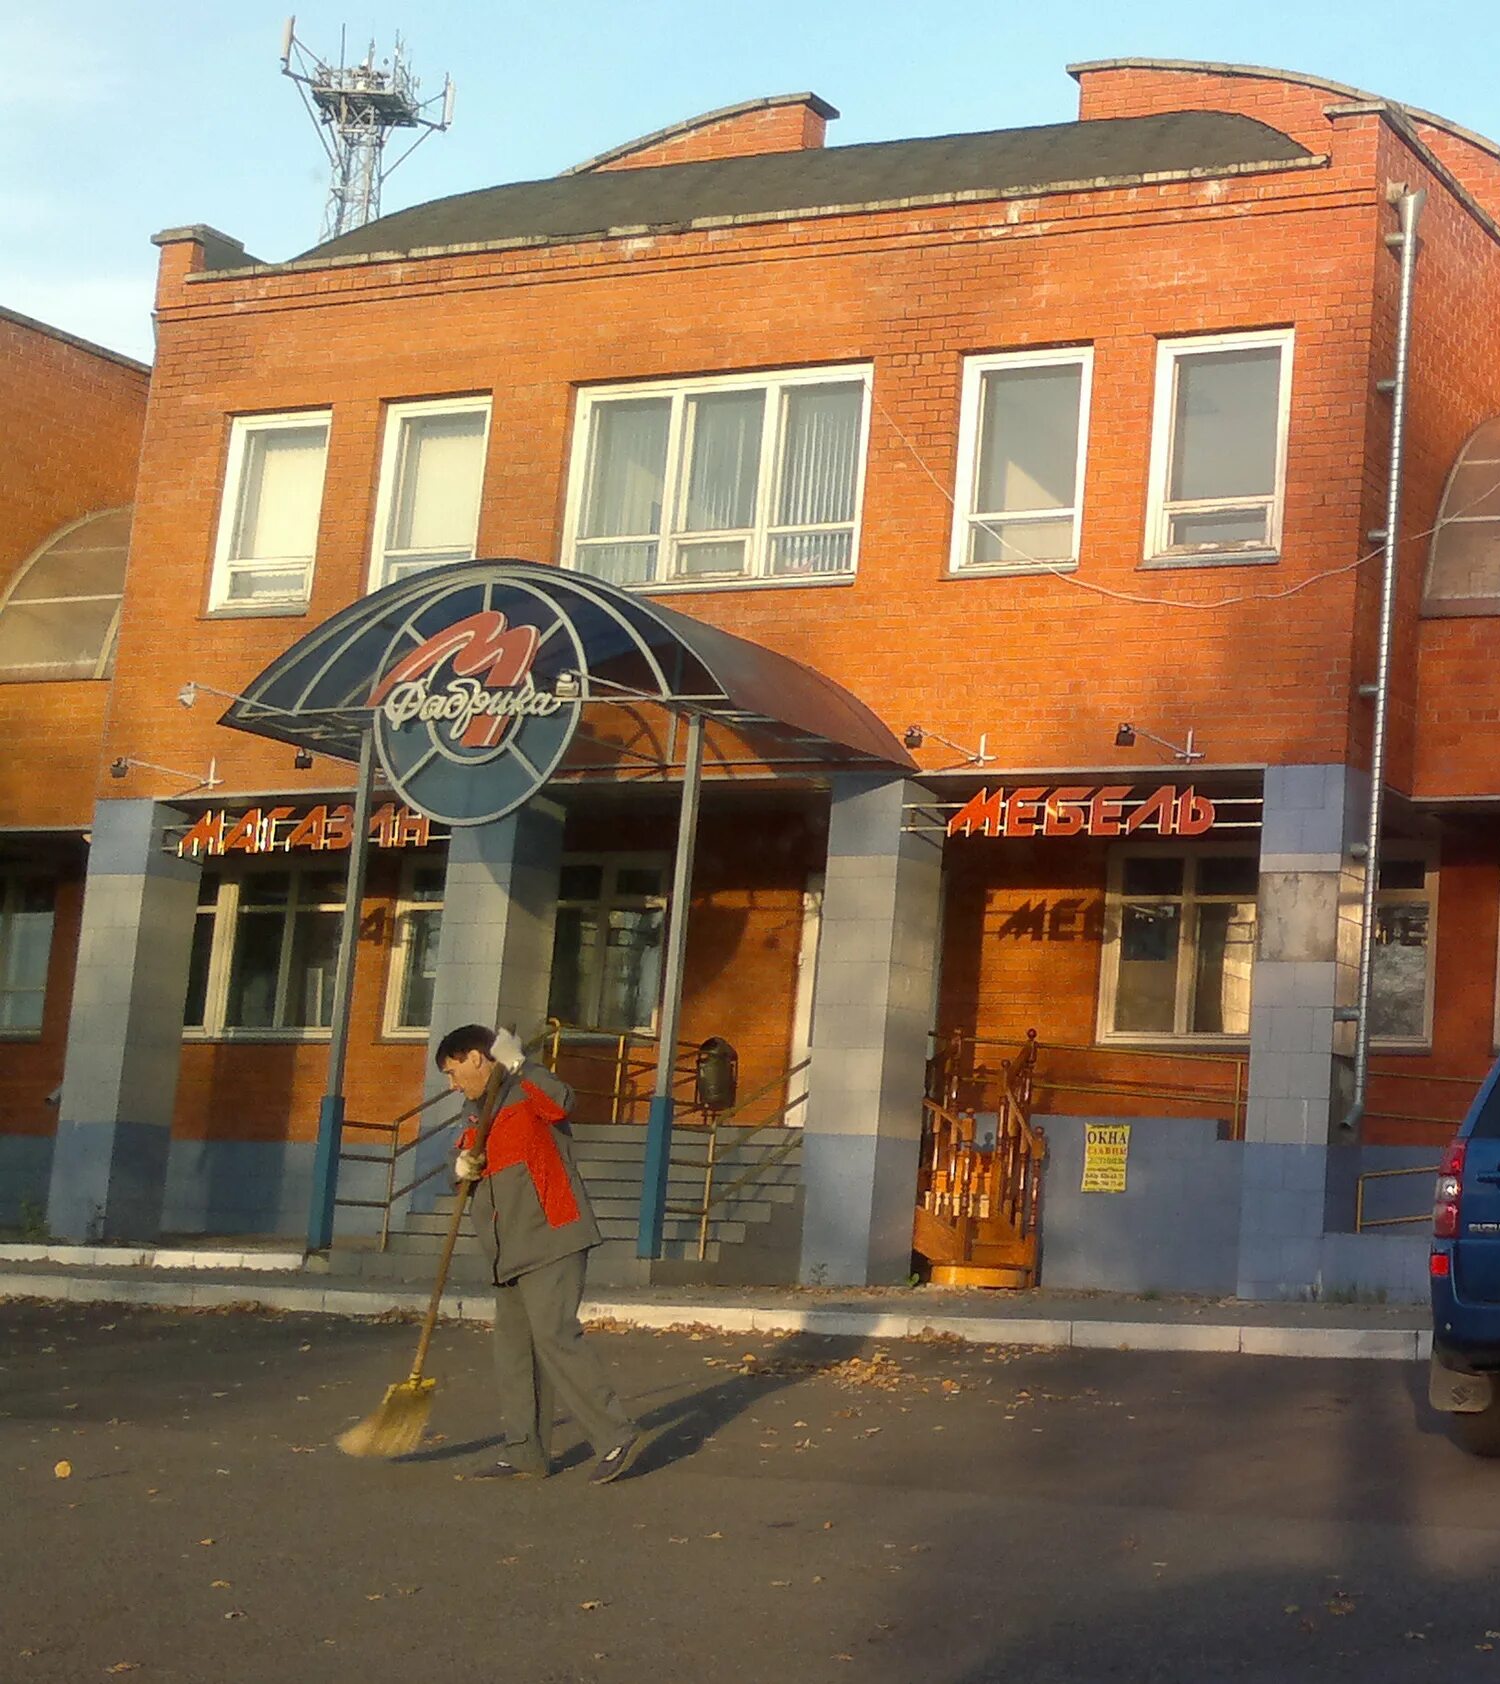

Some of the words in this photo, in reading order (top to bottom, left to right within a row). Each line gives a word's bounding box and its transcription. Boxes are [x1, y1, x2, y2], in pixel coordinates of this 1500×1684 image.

[383, 677, 561, 739] Фабрика
[947, 785, 1216, 838] МЕБЕЛЬ
[1087, 1131, 1126, 1145] ОКНА
